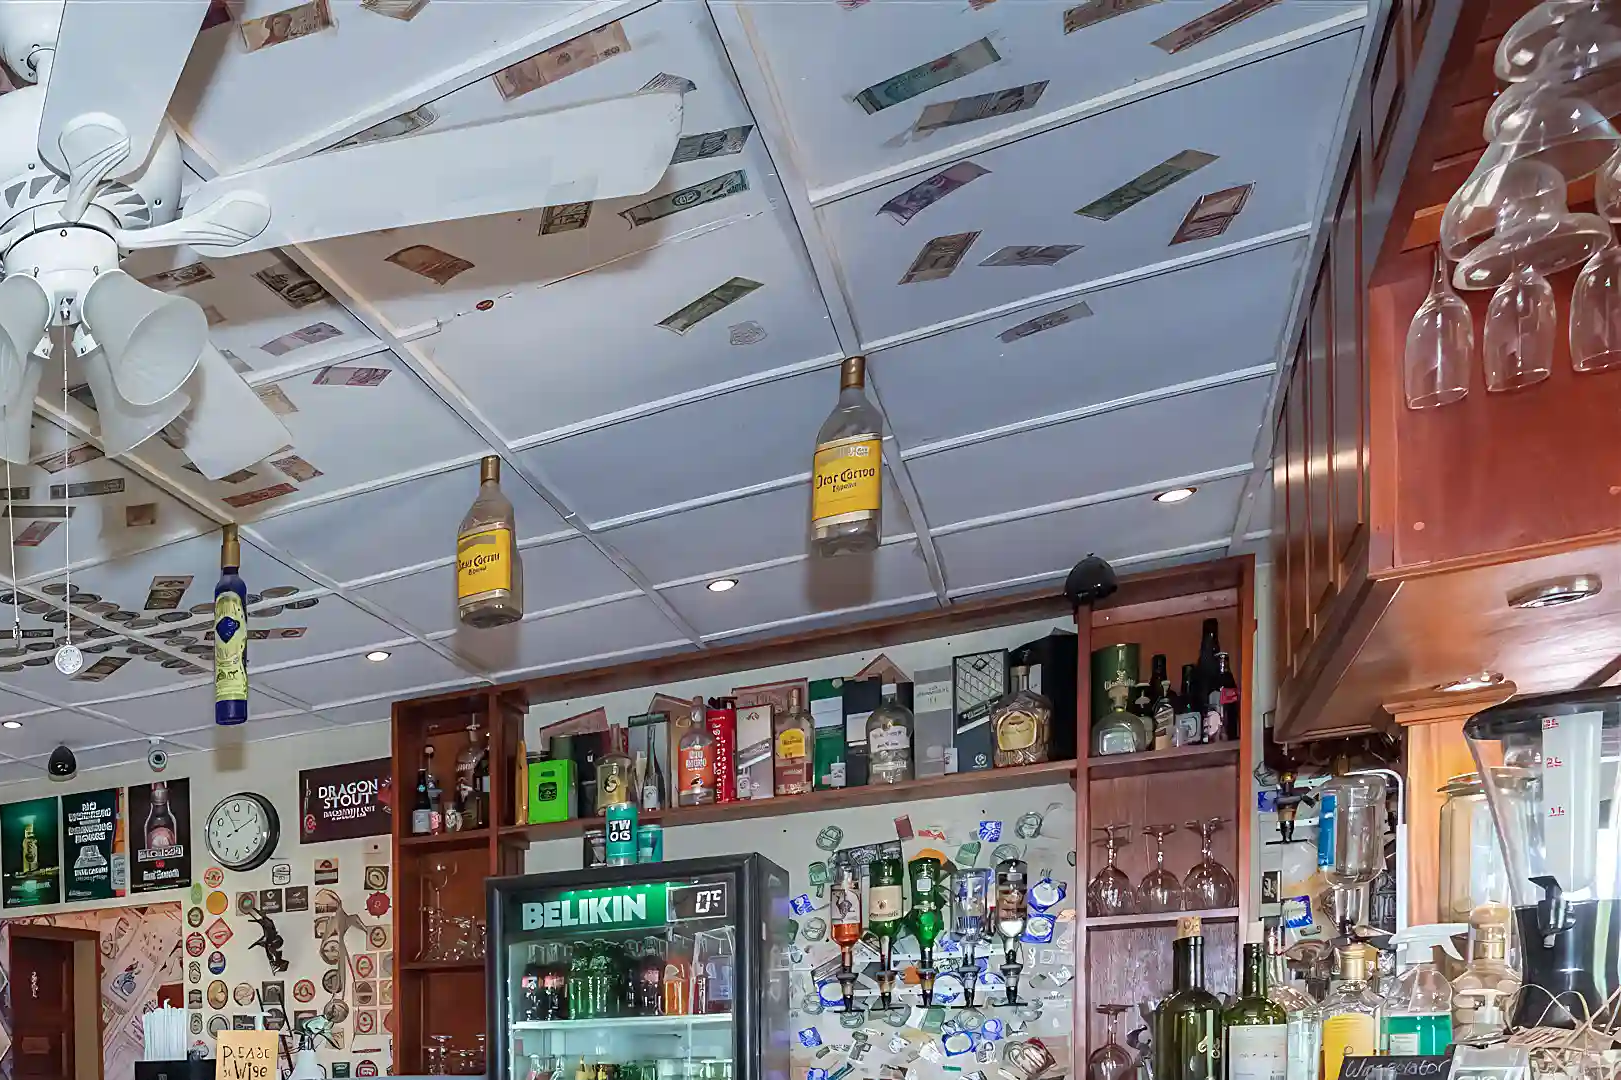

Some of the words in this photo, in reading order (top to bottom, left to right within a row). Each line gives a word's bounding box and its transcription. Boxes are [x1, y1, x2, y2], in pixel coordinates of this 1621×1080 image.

[318, 778, 378, 799] DRAGON
[324, 793, 370, 809] STOUT
[522, 893, 647, 931] BELIKIN
